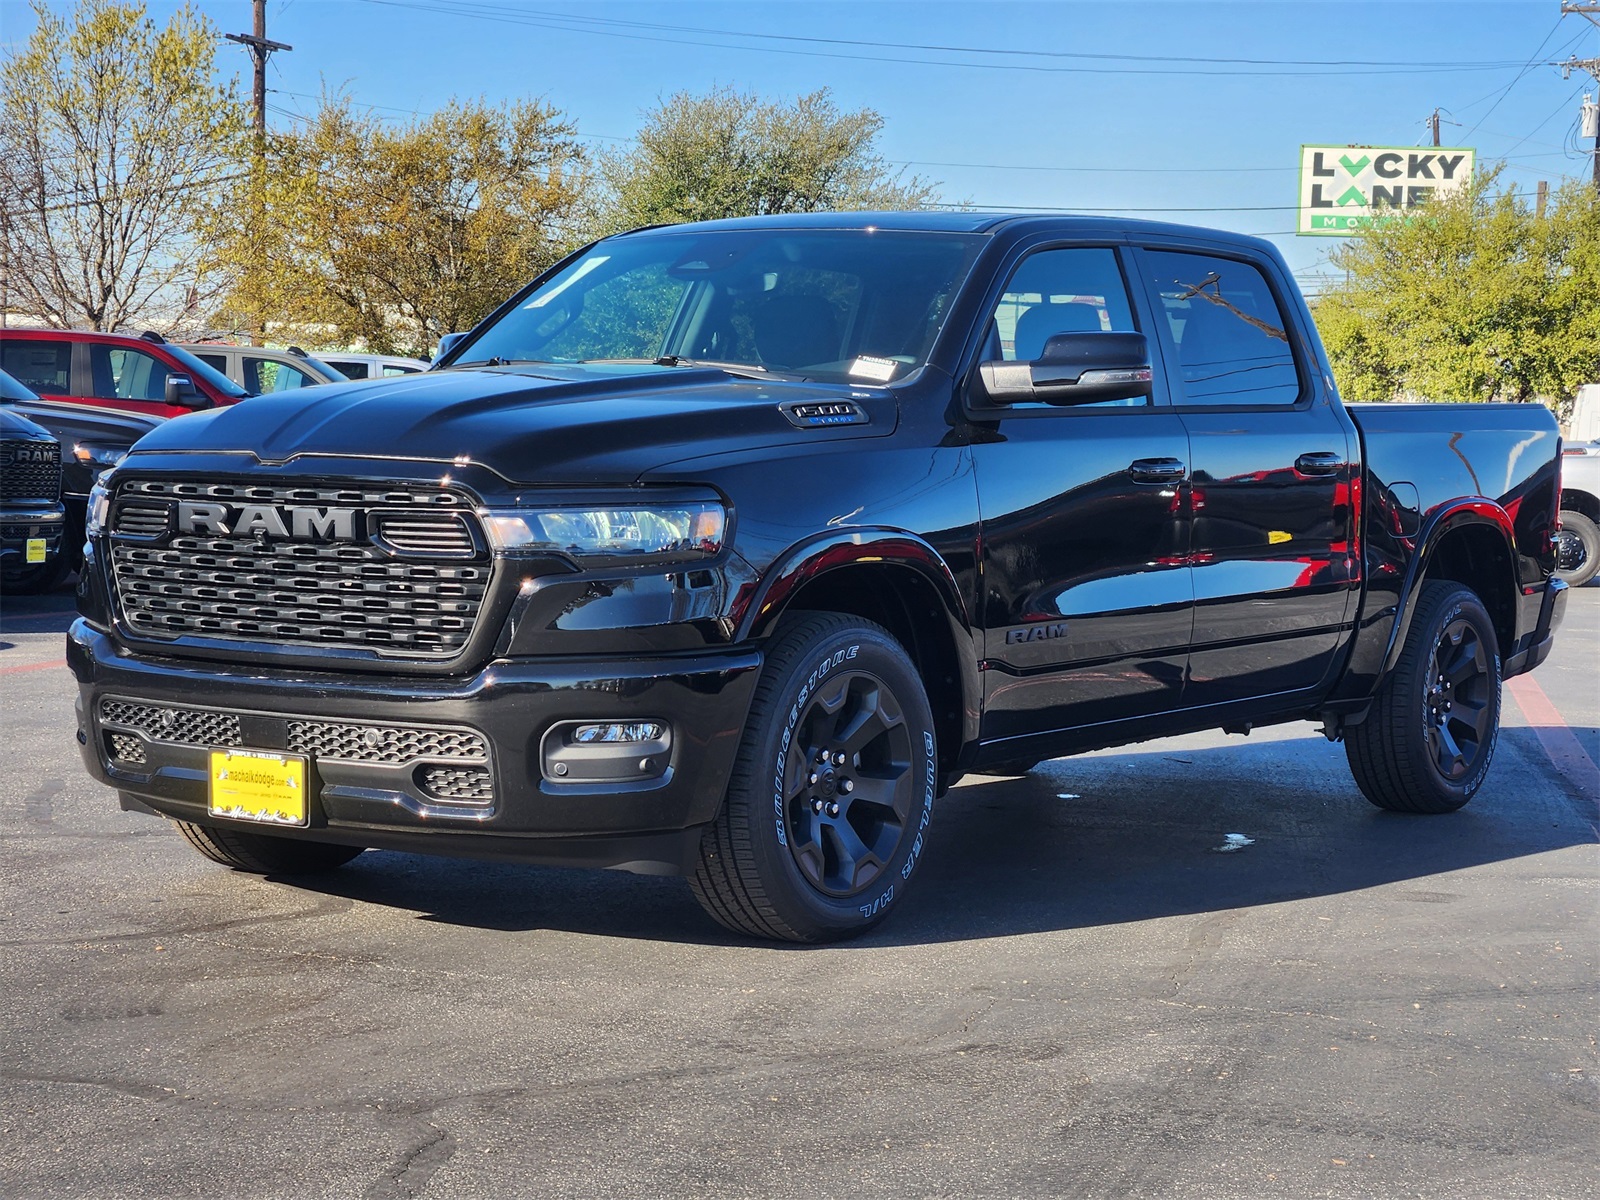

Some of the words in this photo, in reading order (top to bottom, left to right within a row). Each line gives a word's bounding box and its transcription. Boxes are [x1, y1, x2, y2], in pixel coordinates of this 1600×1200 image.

[794, 404, 853, 418] 1500
[17, 450, 53, 462] RAM
[178, 501, 356, 540] RAM
[1006, 624, 1068, 645] RAM
[774, 645, 860, 847] BRIDGESTONE
[901, 730, 935, 880] DUELER
[859, 885, 894, 919] H/L
